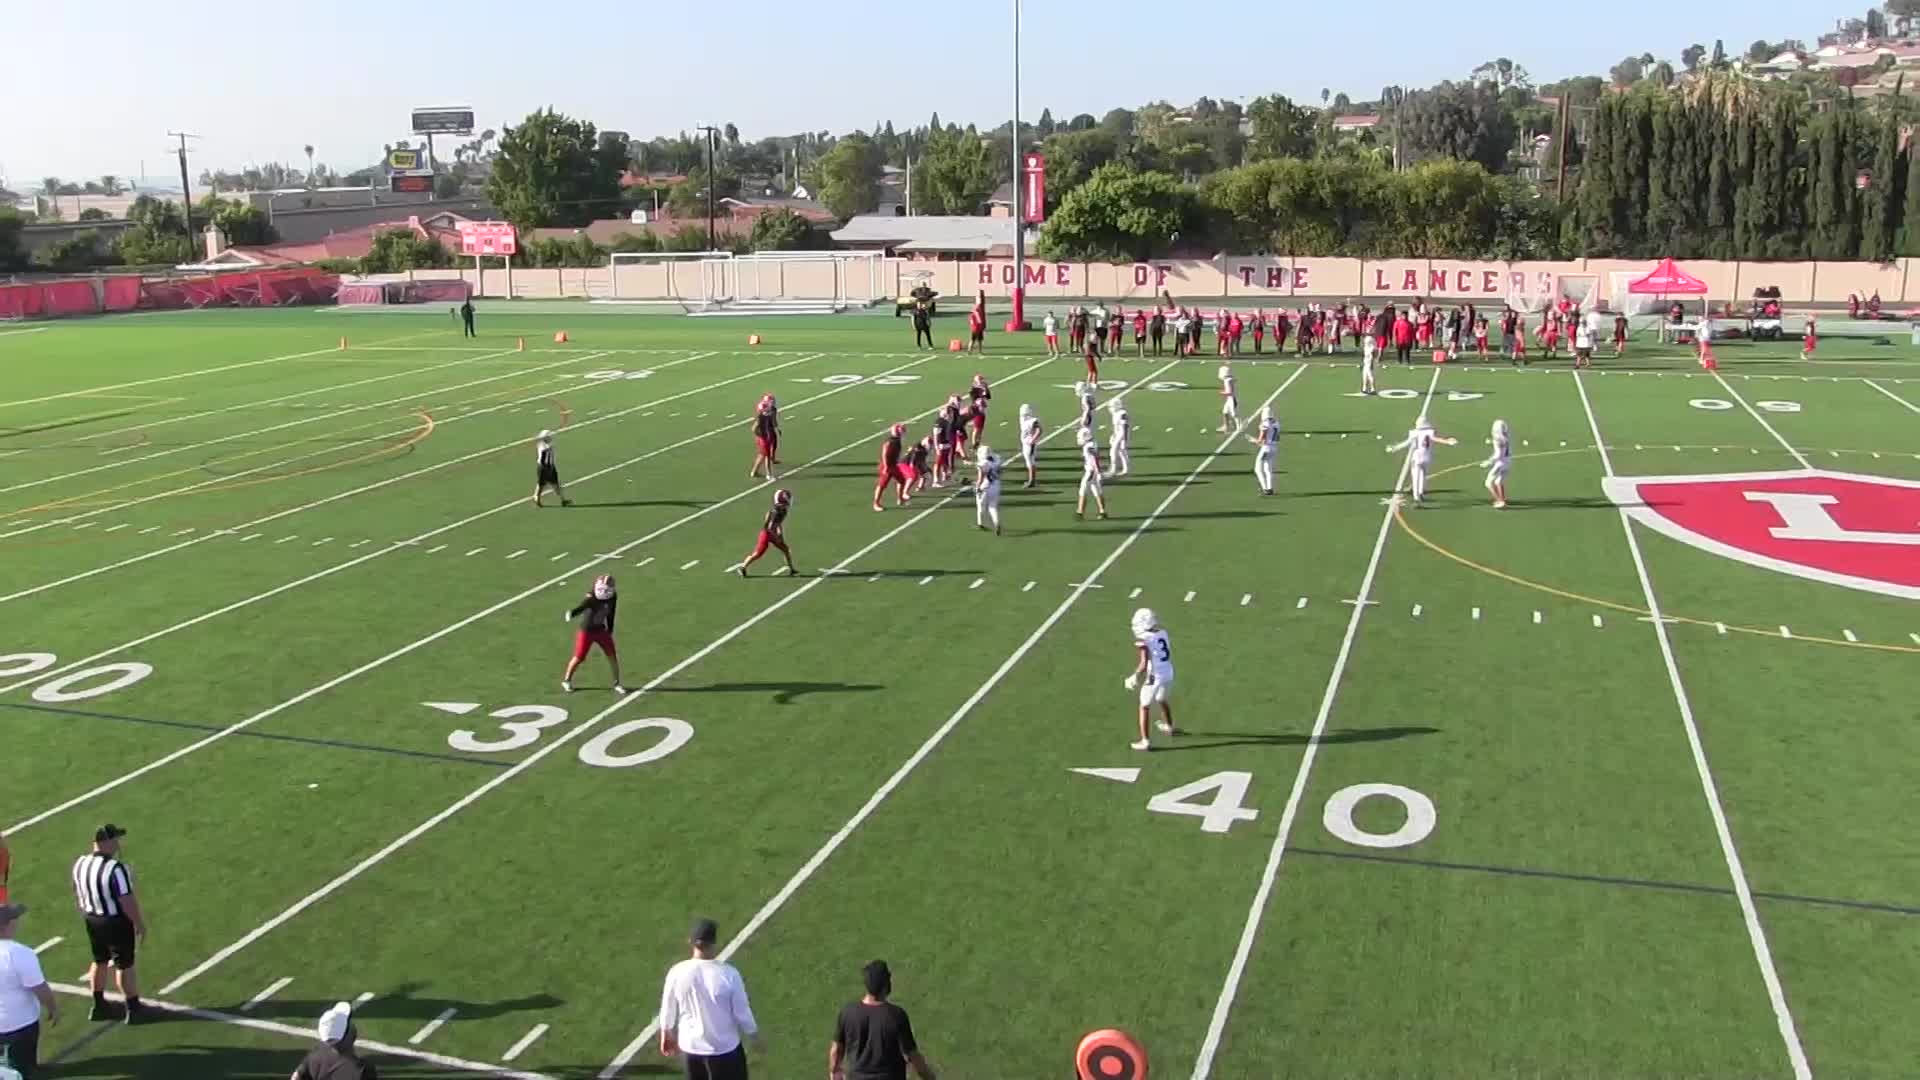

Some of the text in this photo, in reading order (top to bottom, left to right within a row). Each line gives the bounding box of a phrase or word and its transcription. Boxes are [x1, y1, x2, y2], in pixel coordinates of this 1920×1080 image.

[978, 264, 1070, 285] HOME
[1134, 265, 1172, 286] OF
[1239, 266, 1308, 289] THE
[1158, 638, 1170, 662] 3
